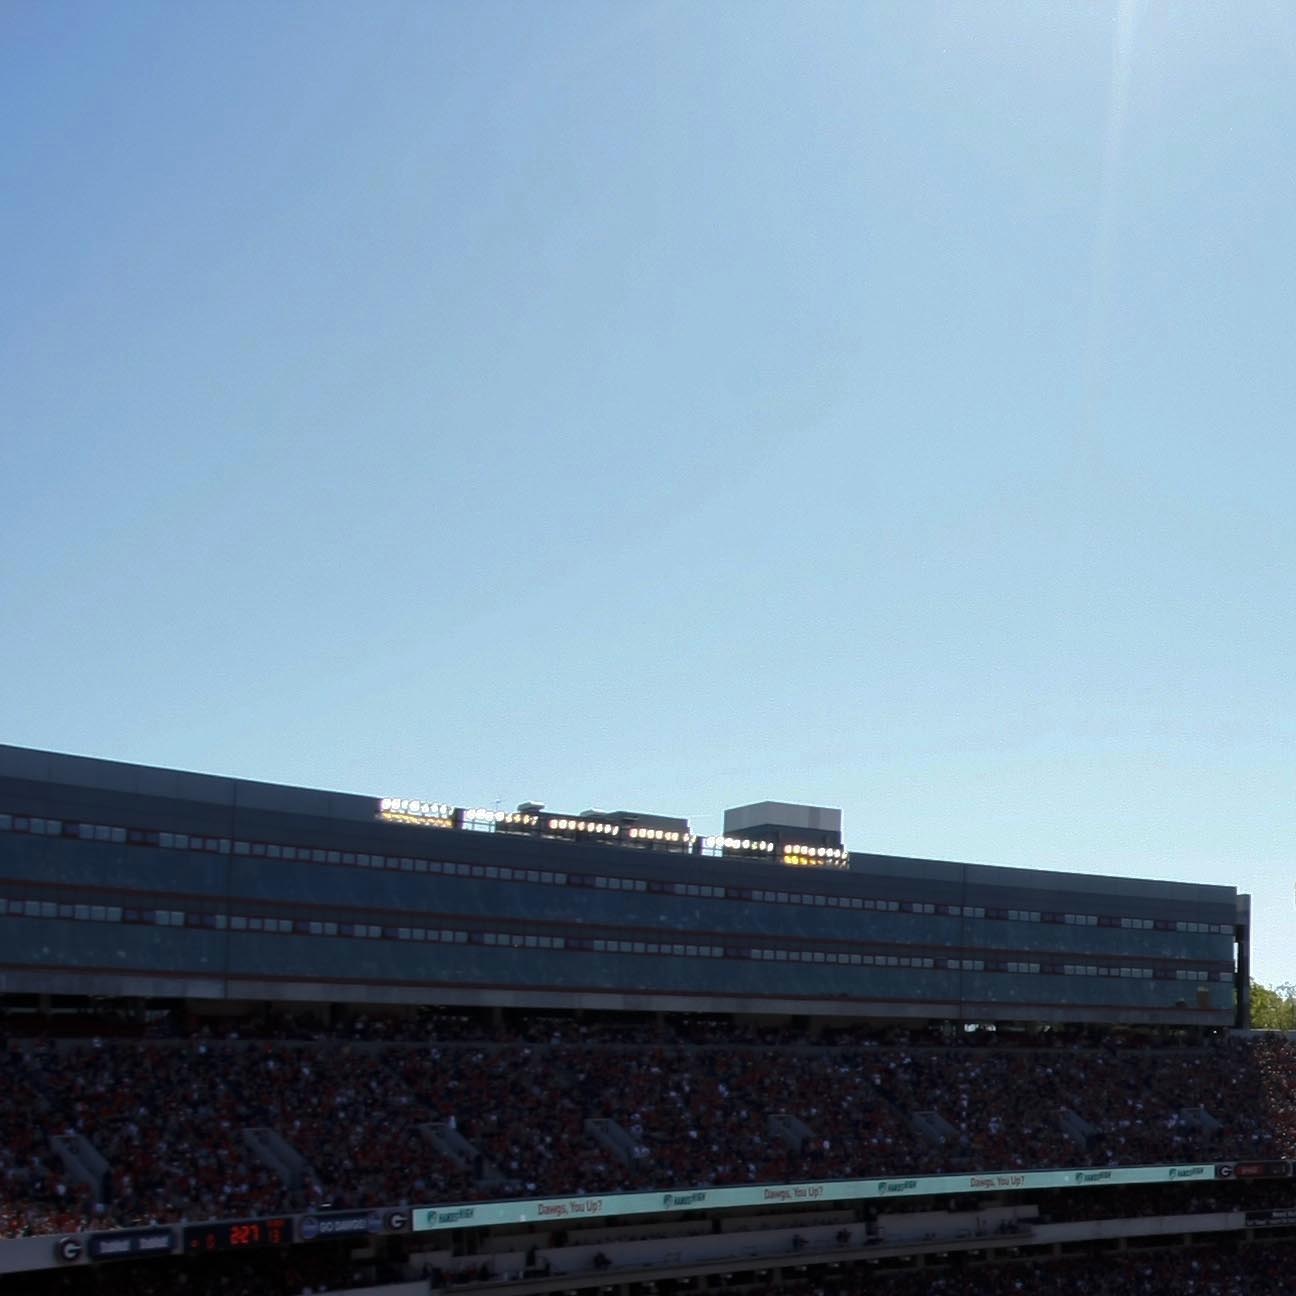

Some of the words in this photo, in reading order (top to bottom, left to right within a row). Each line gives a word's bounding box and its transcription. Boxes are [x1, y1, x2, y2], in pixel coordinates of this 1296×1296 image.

[996, 1177, 1009, 1187] You
[1011, 1176, 1025, 1187] Up?
[791, 1188, 807, 1198] You
[808, 1187, 823, 1198] Up?
[570, 1201, 585, 1213] You
[586, 1199, 603, 1213] Up?
